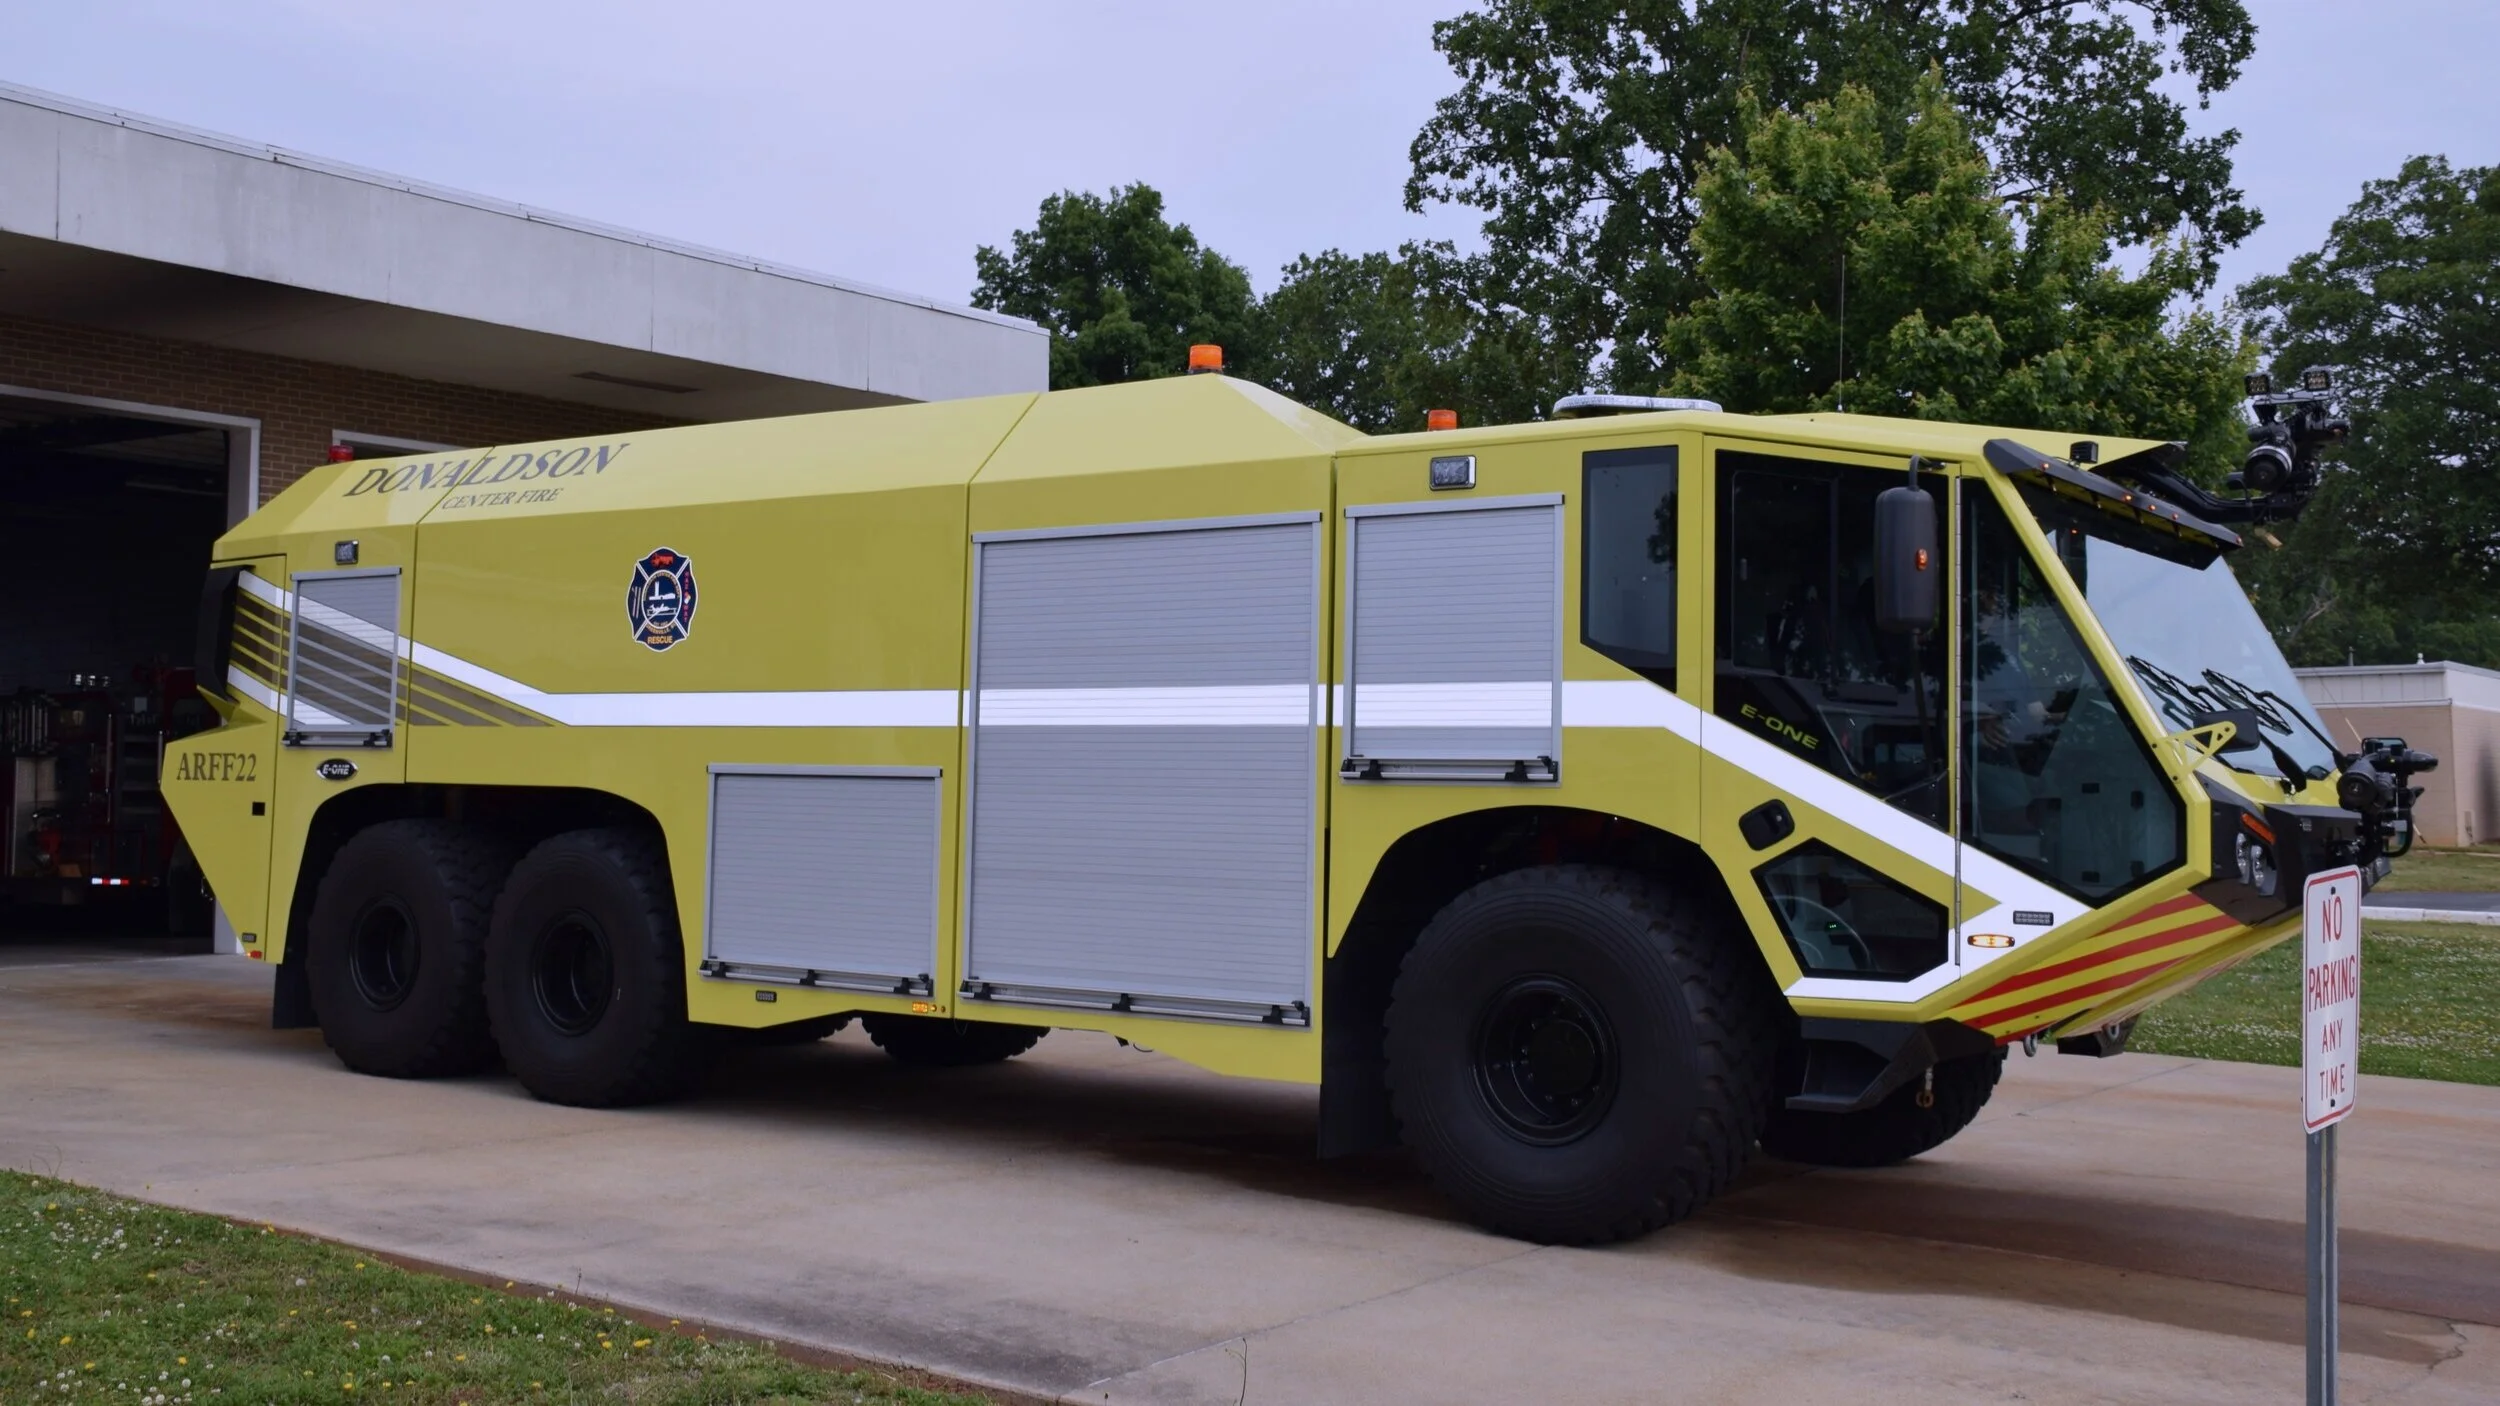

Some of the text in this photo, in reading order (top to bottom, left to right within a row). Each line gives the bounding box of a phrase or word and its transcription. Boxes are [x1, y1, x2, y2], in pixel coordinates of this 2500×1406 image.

[343, 443, 630, 497] DONALDSON
[441, 487, 564, 510] CENTER FIRE
[647, 635, 673, 645] RESCUE
[1740, 703, 1819, 750] E-ONE
[176, 752, 257, 782] ARFF22
[322, 763, 350, 775] E-ONE
[2322, 896, 2343, 944] NO
[2308, 954, 2356, 1013] PARKING
[2321, 1018, 2344, 1054] ANY
[2319, 1063, 2346, 1101] TIME
